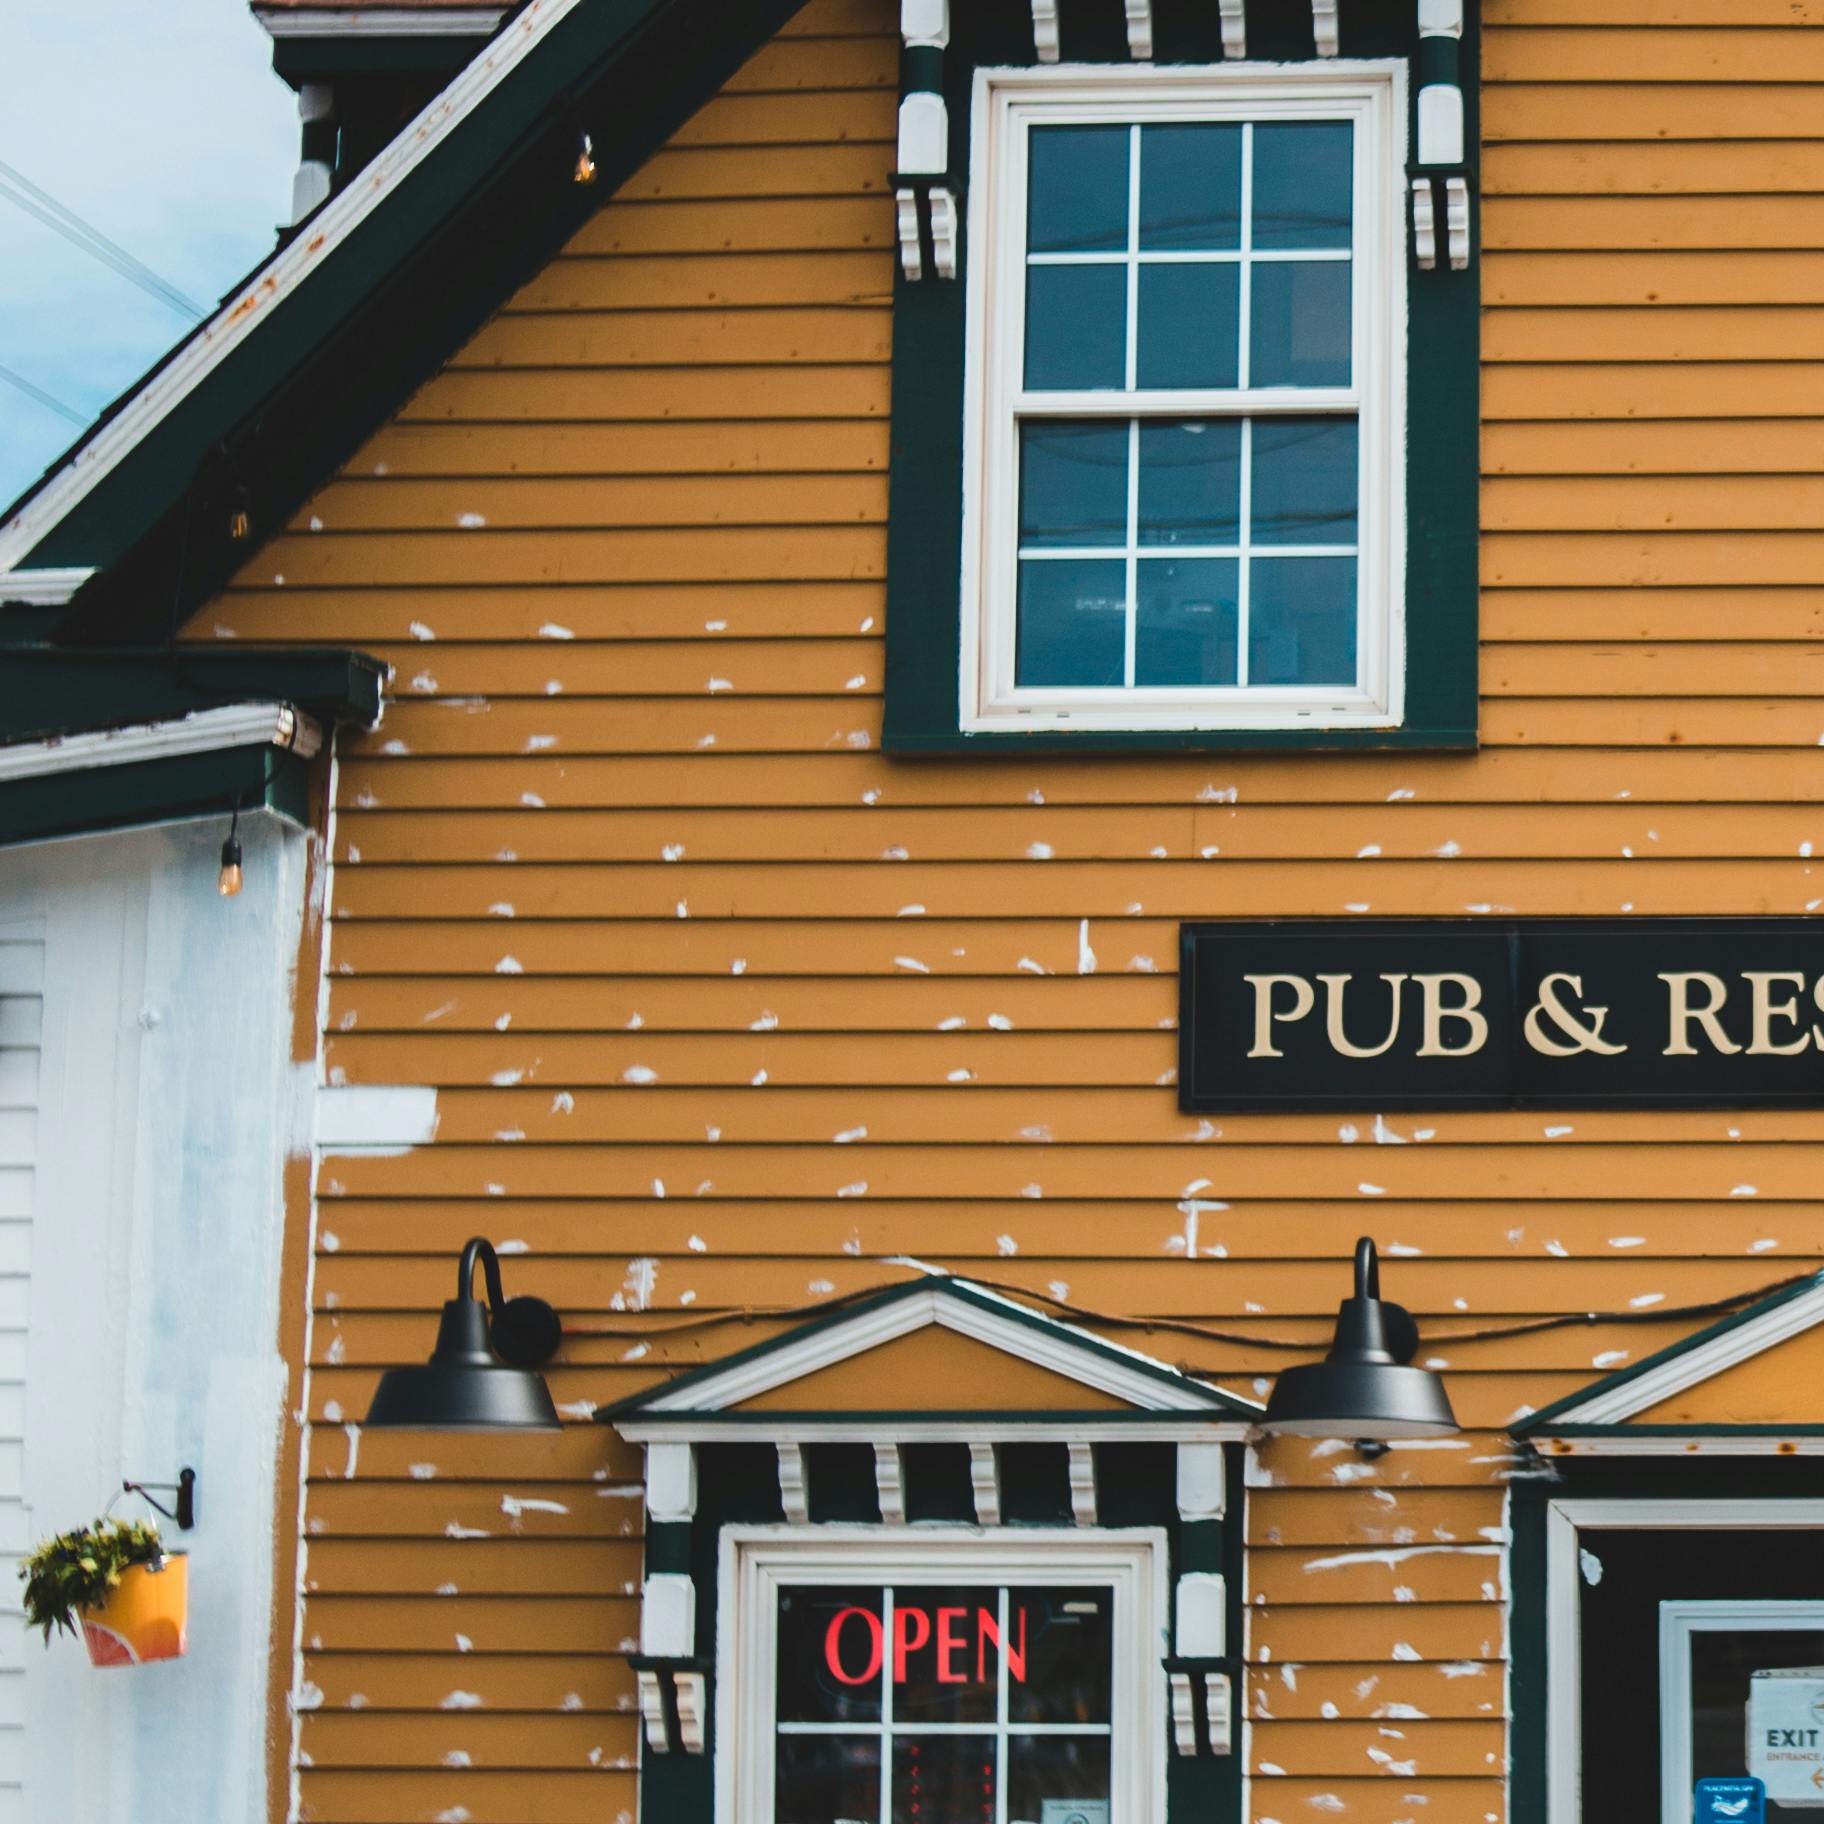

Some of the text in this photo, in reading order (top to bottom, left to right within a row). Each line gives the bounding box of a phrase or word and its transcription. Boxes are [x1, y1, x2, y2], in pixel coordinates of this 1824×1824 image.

[1243, 972, 1489, 1058] PUB
[1524, 972, 1628, 1058] &
[824, 1605, 1027, 1686] OPEN
[1766, 1729, 1819, 1748] EXIT
[1766, 1752, 1820, 1762] ENTRANCE
